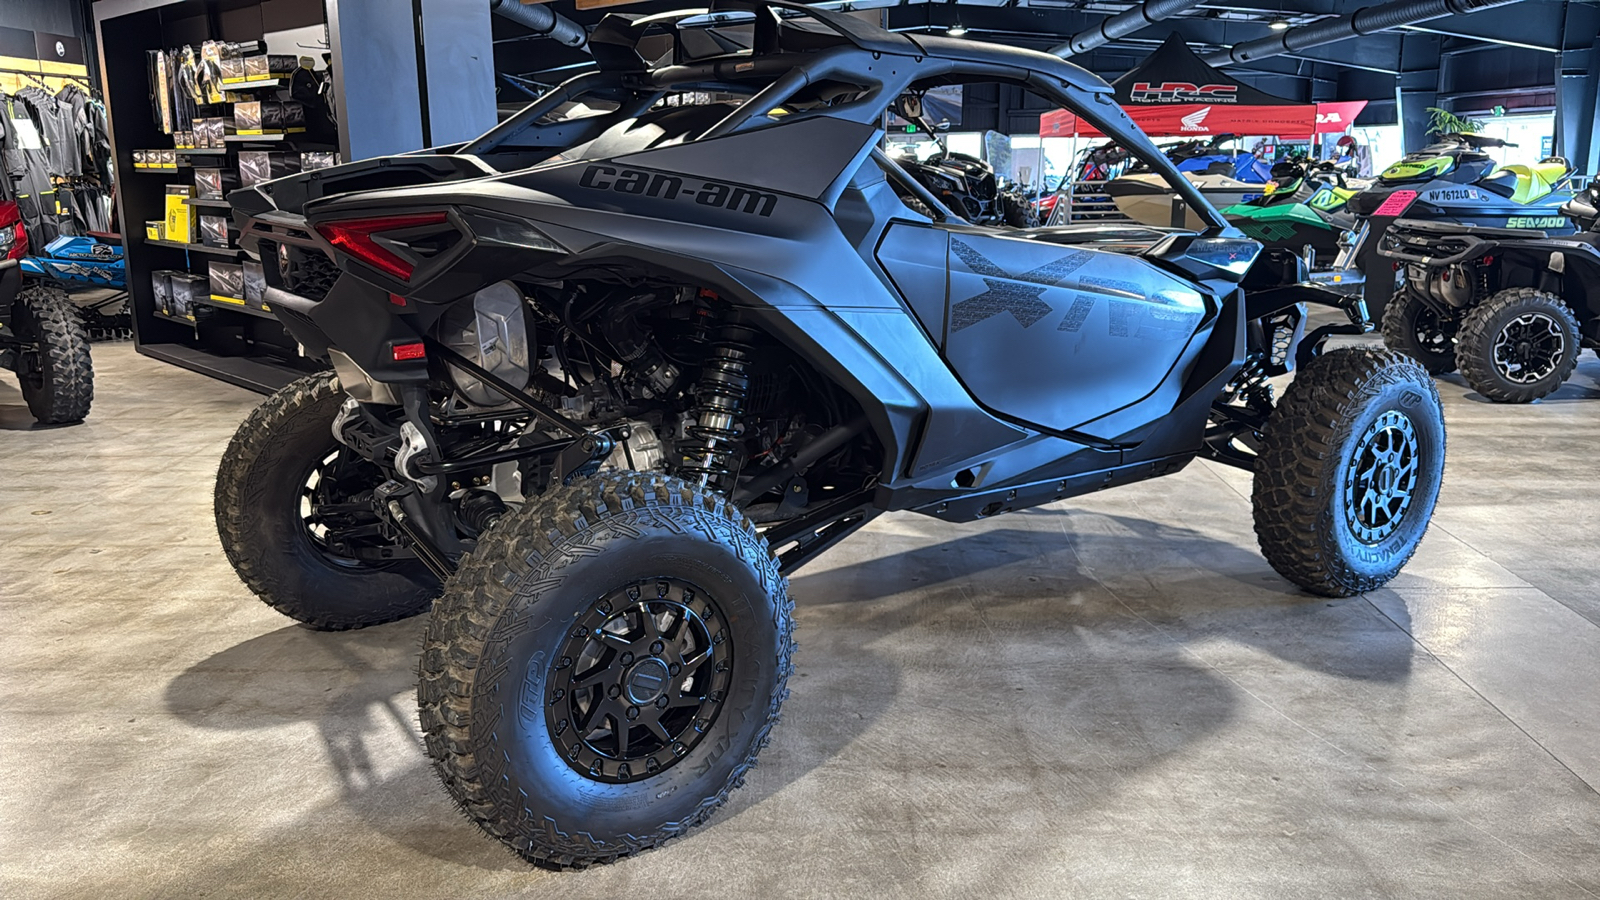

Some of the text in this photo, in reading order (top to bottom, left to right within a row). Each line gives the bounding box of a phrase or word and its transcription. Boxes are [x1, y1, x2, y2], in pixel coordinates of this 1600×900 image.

[1130, 82, 1238, 99] HRC
[579, 165, 778, 217] can-am
[1429, 190, 1440, 201] NV
[1401, 390, 1423, 408] ITP
[1355, 534, 1408, 564] TENACITY
[518, 651, 547, 730] ITP
